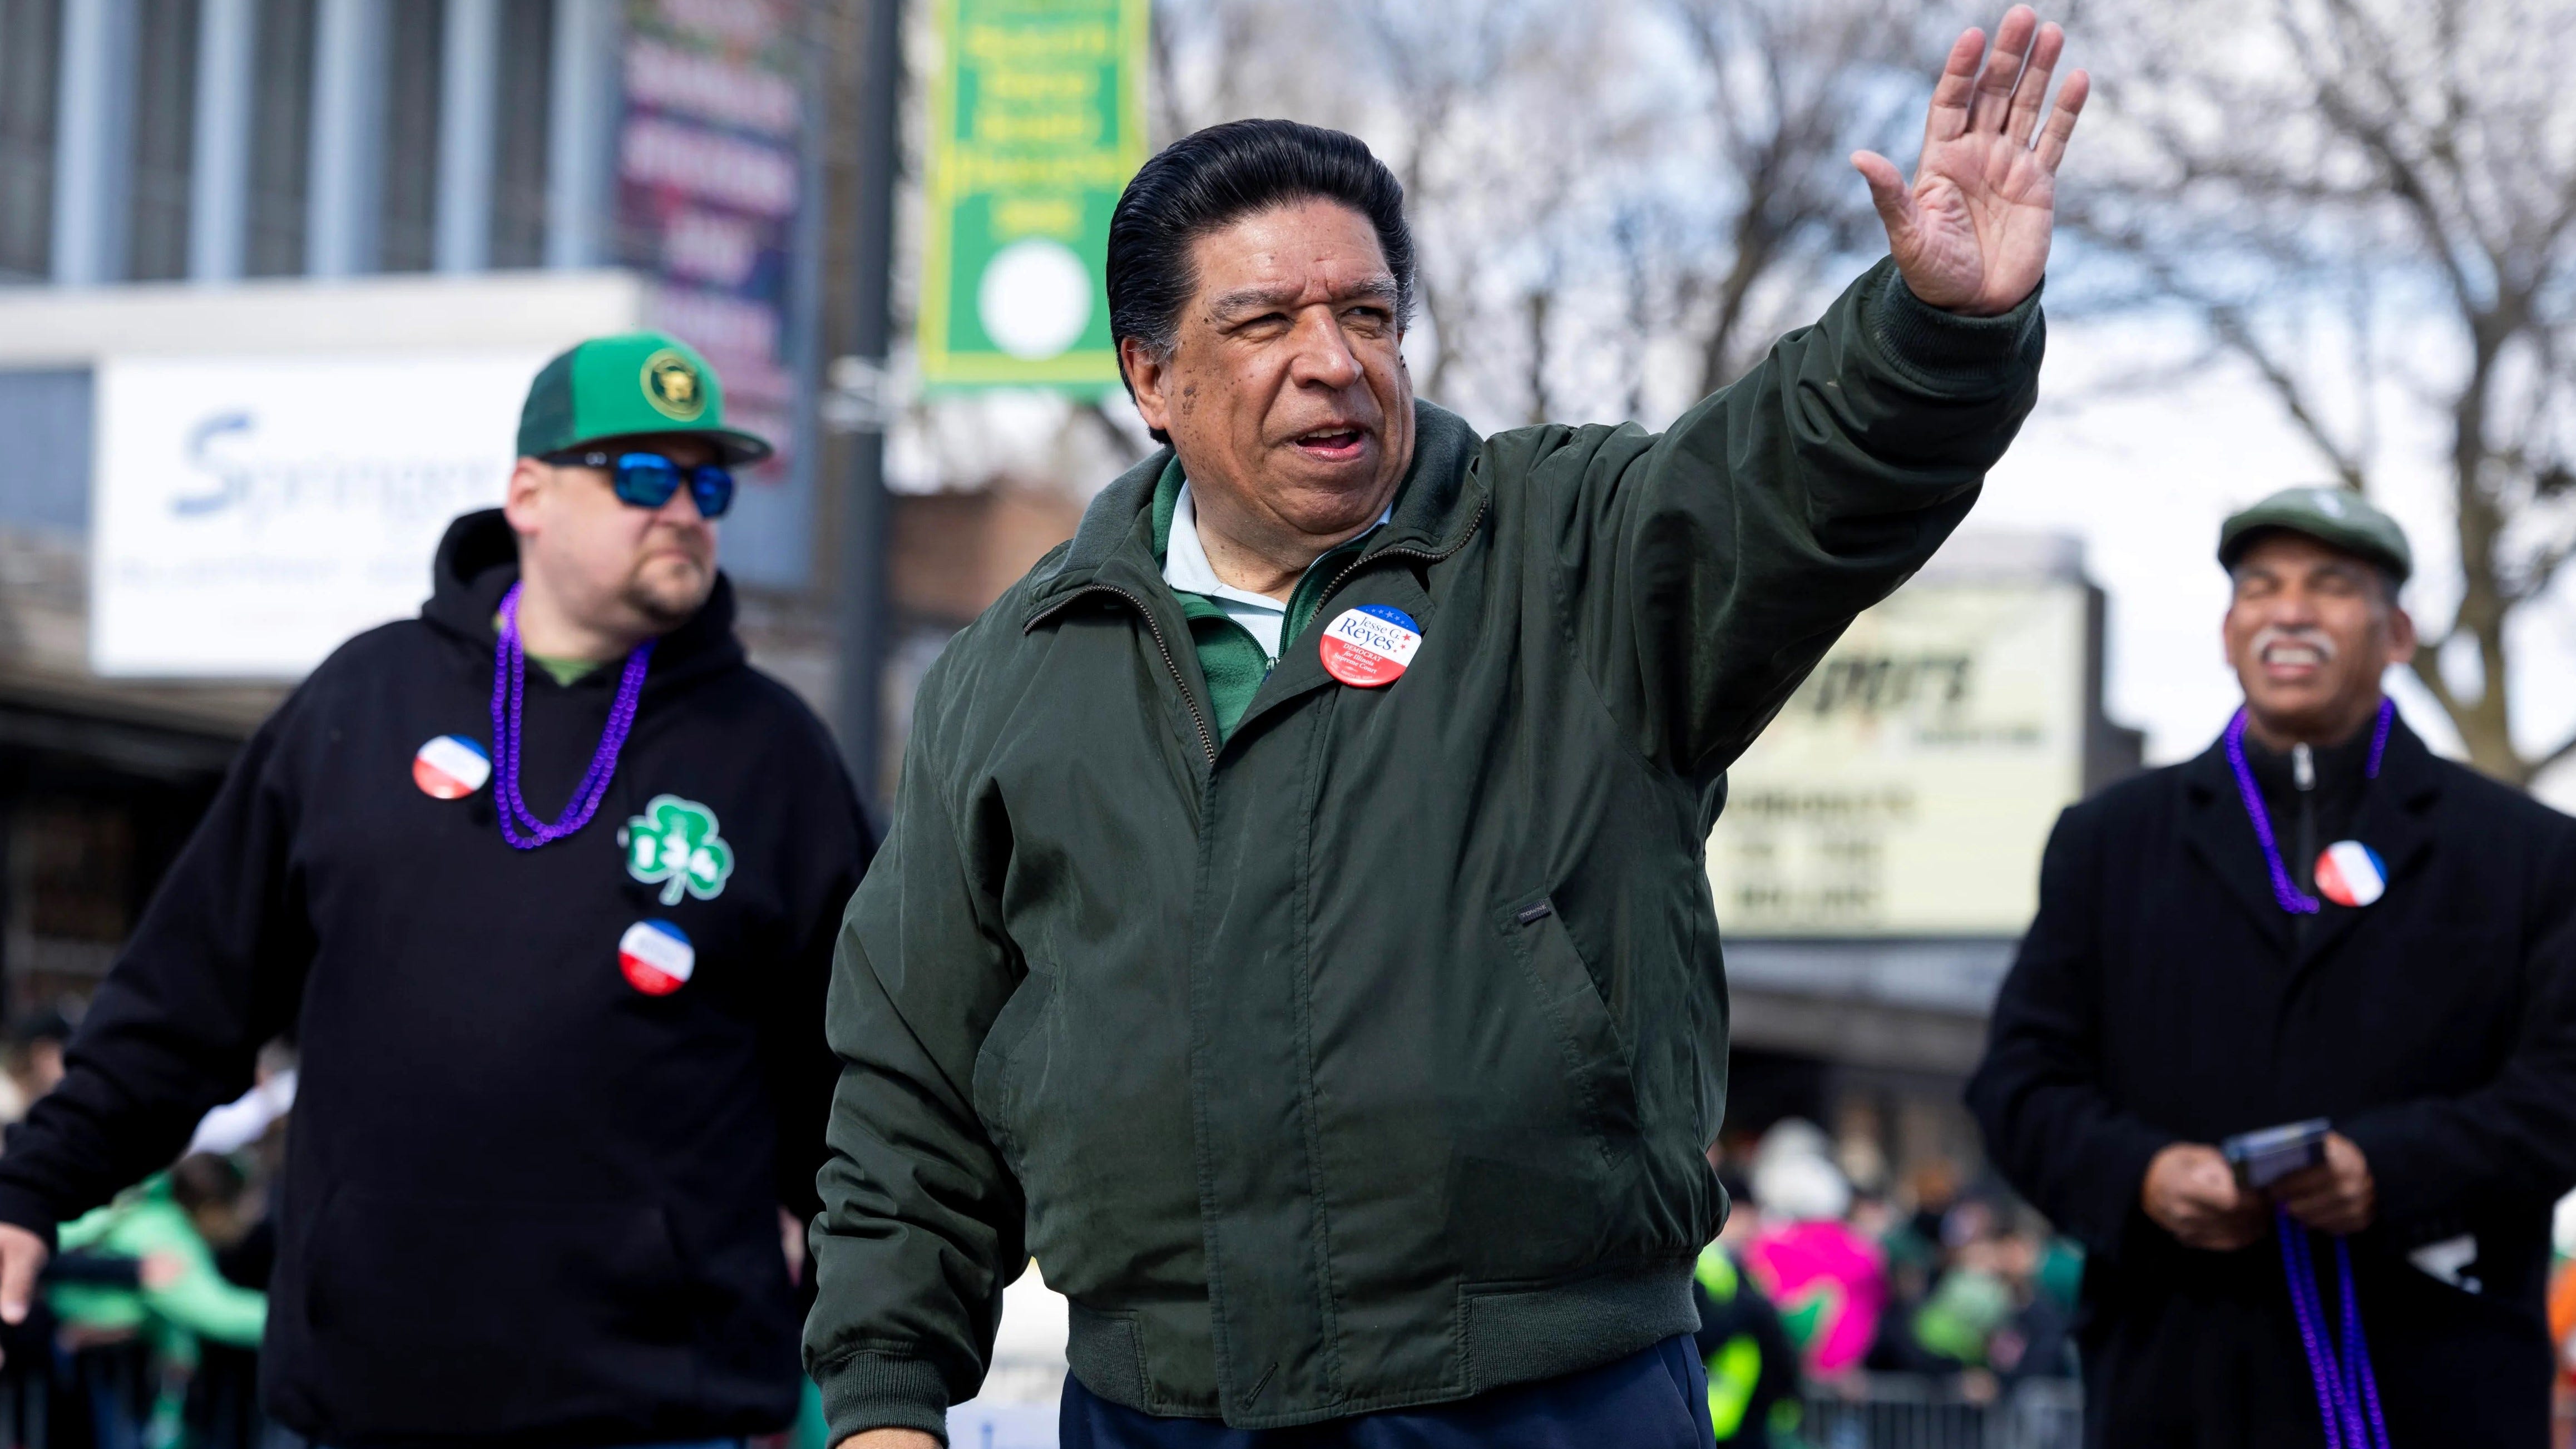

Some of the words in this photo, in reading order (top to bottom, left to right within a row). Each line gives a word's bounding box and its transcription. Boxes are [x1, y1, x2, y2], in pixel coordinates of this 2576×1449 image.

[1338, 617, 1395, 650] Reyes
[1359, 617, 1387, 634] Jesse
[1390, 629, 1401, 640] G.
[1343, 643, 1383, 661] DEMOCRAT
[1353, 654, 1374, 666] Illinois
[1334, 652, 1359, 666] Supreme
[1359, 662, 1377, 674] Court
[1520, 904, 1546, 917] TOWNE
